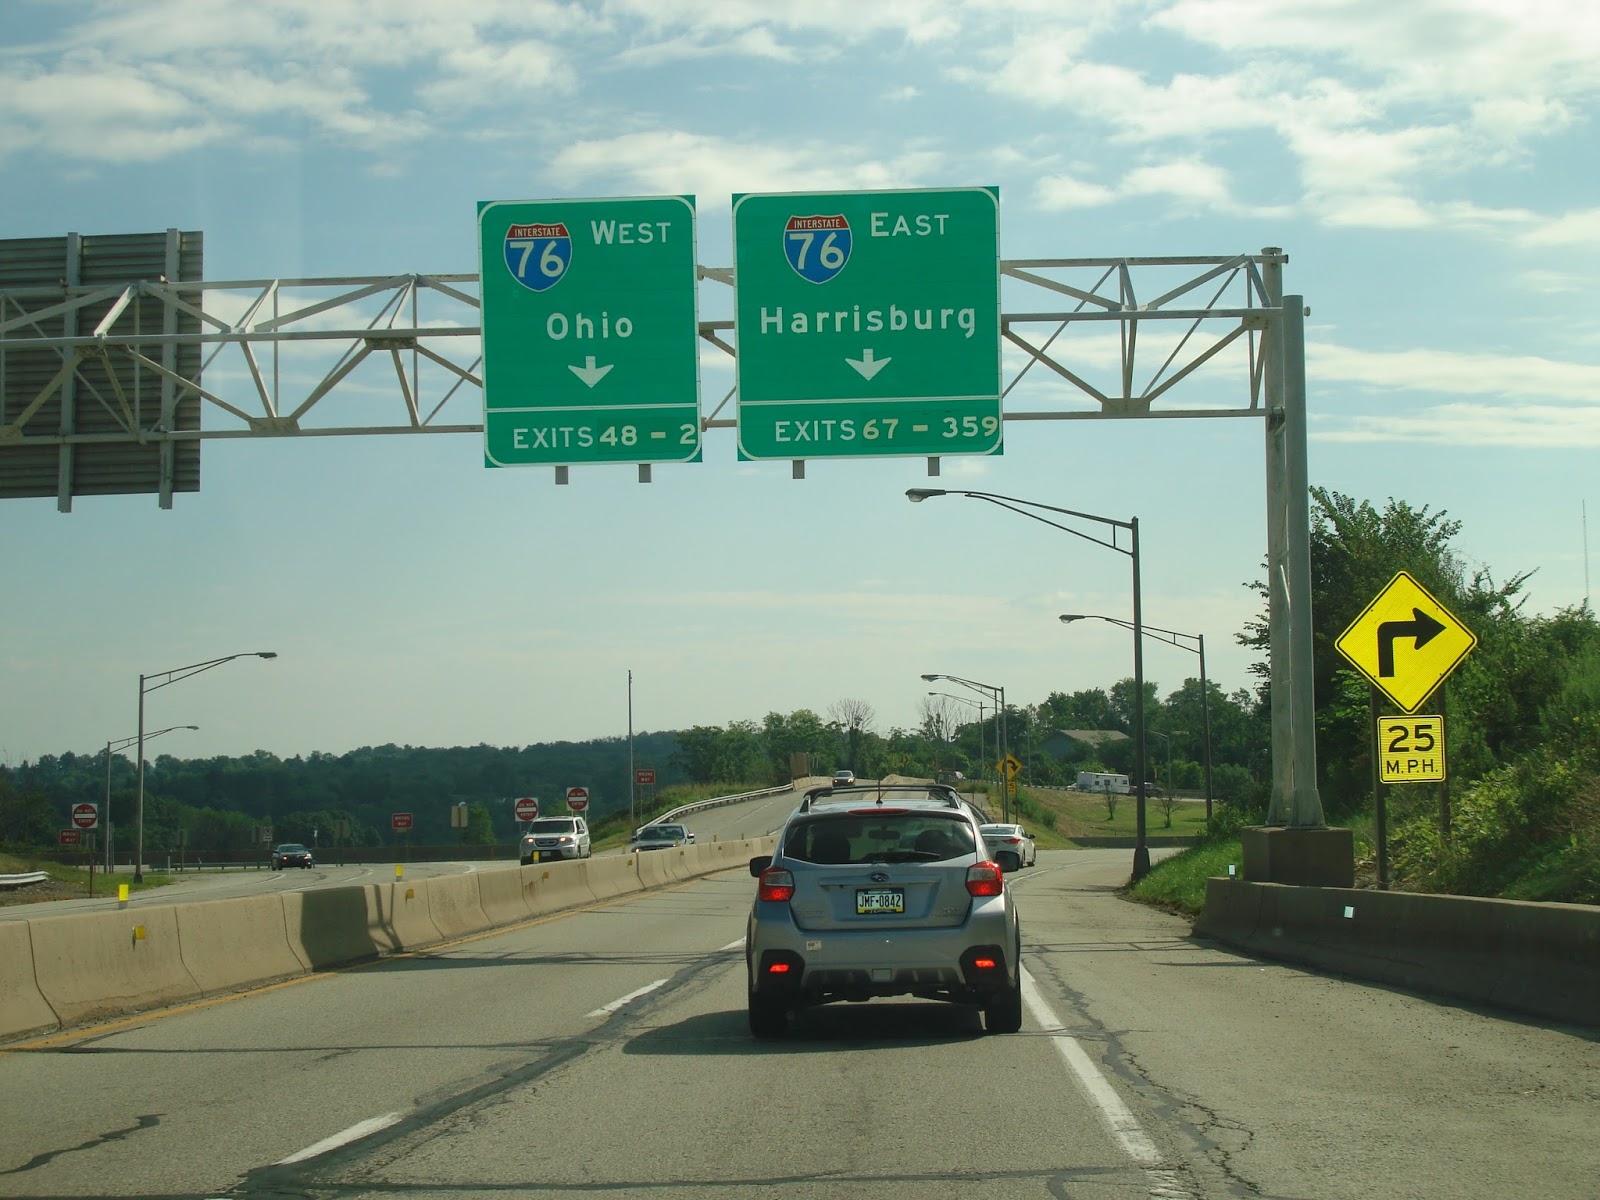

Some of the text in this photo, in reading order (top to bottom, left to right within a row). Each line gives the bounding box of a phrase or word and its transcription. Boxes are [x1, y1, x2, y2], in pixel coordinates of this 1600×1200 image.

[514, 226, 561, 237] INTERSTATE
[590, 220, 672, 245] WEST
[794, 218, 841, 229] INTERSTATE
[870, 212, 950, 237] EAST
[509, 239, 565, 278] 76
[789, 231, 844, 270] 76
[546, 311, 634, 341] Ohio
[760, 304, 976, 339] Harrisburg
[513, 426, 594, 449] EXITS
[600, 425, 638, 447] 48
[679, 423, 696, 445] 2
[775, 419, 856, 442] EXITS
[862, 418, 899, 440] 67
[942, 415, 998, 438] 359
[1387, 724, 1435, 753] 25
[1386, 759, 1439, 774] M.P.H.
